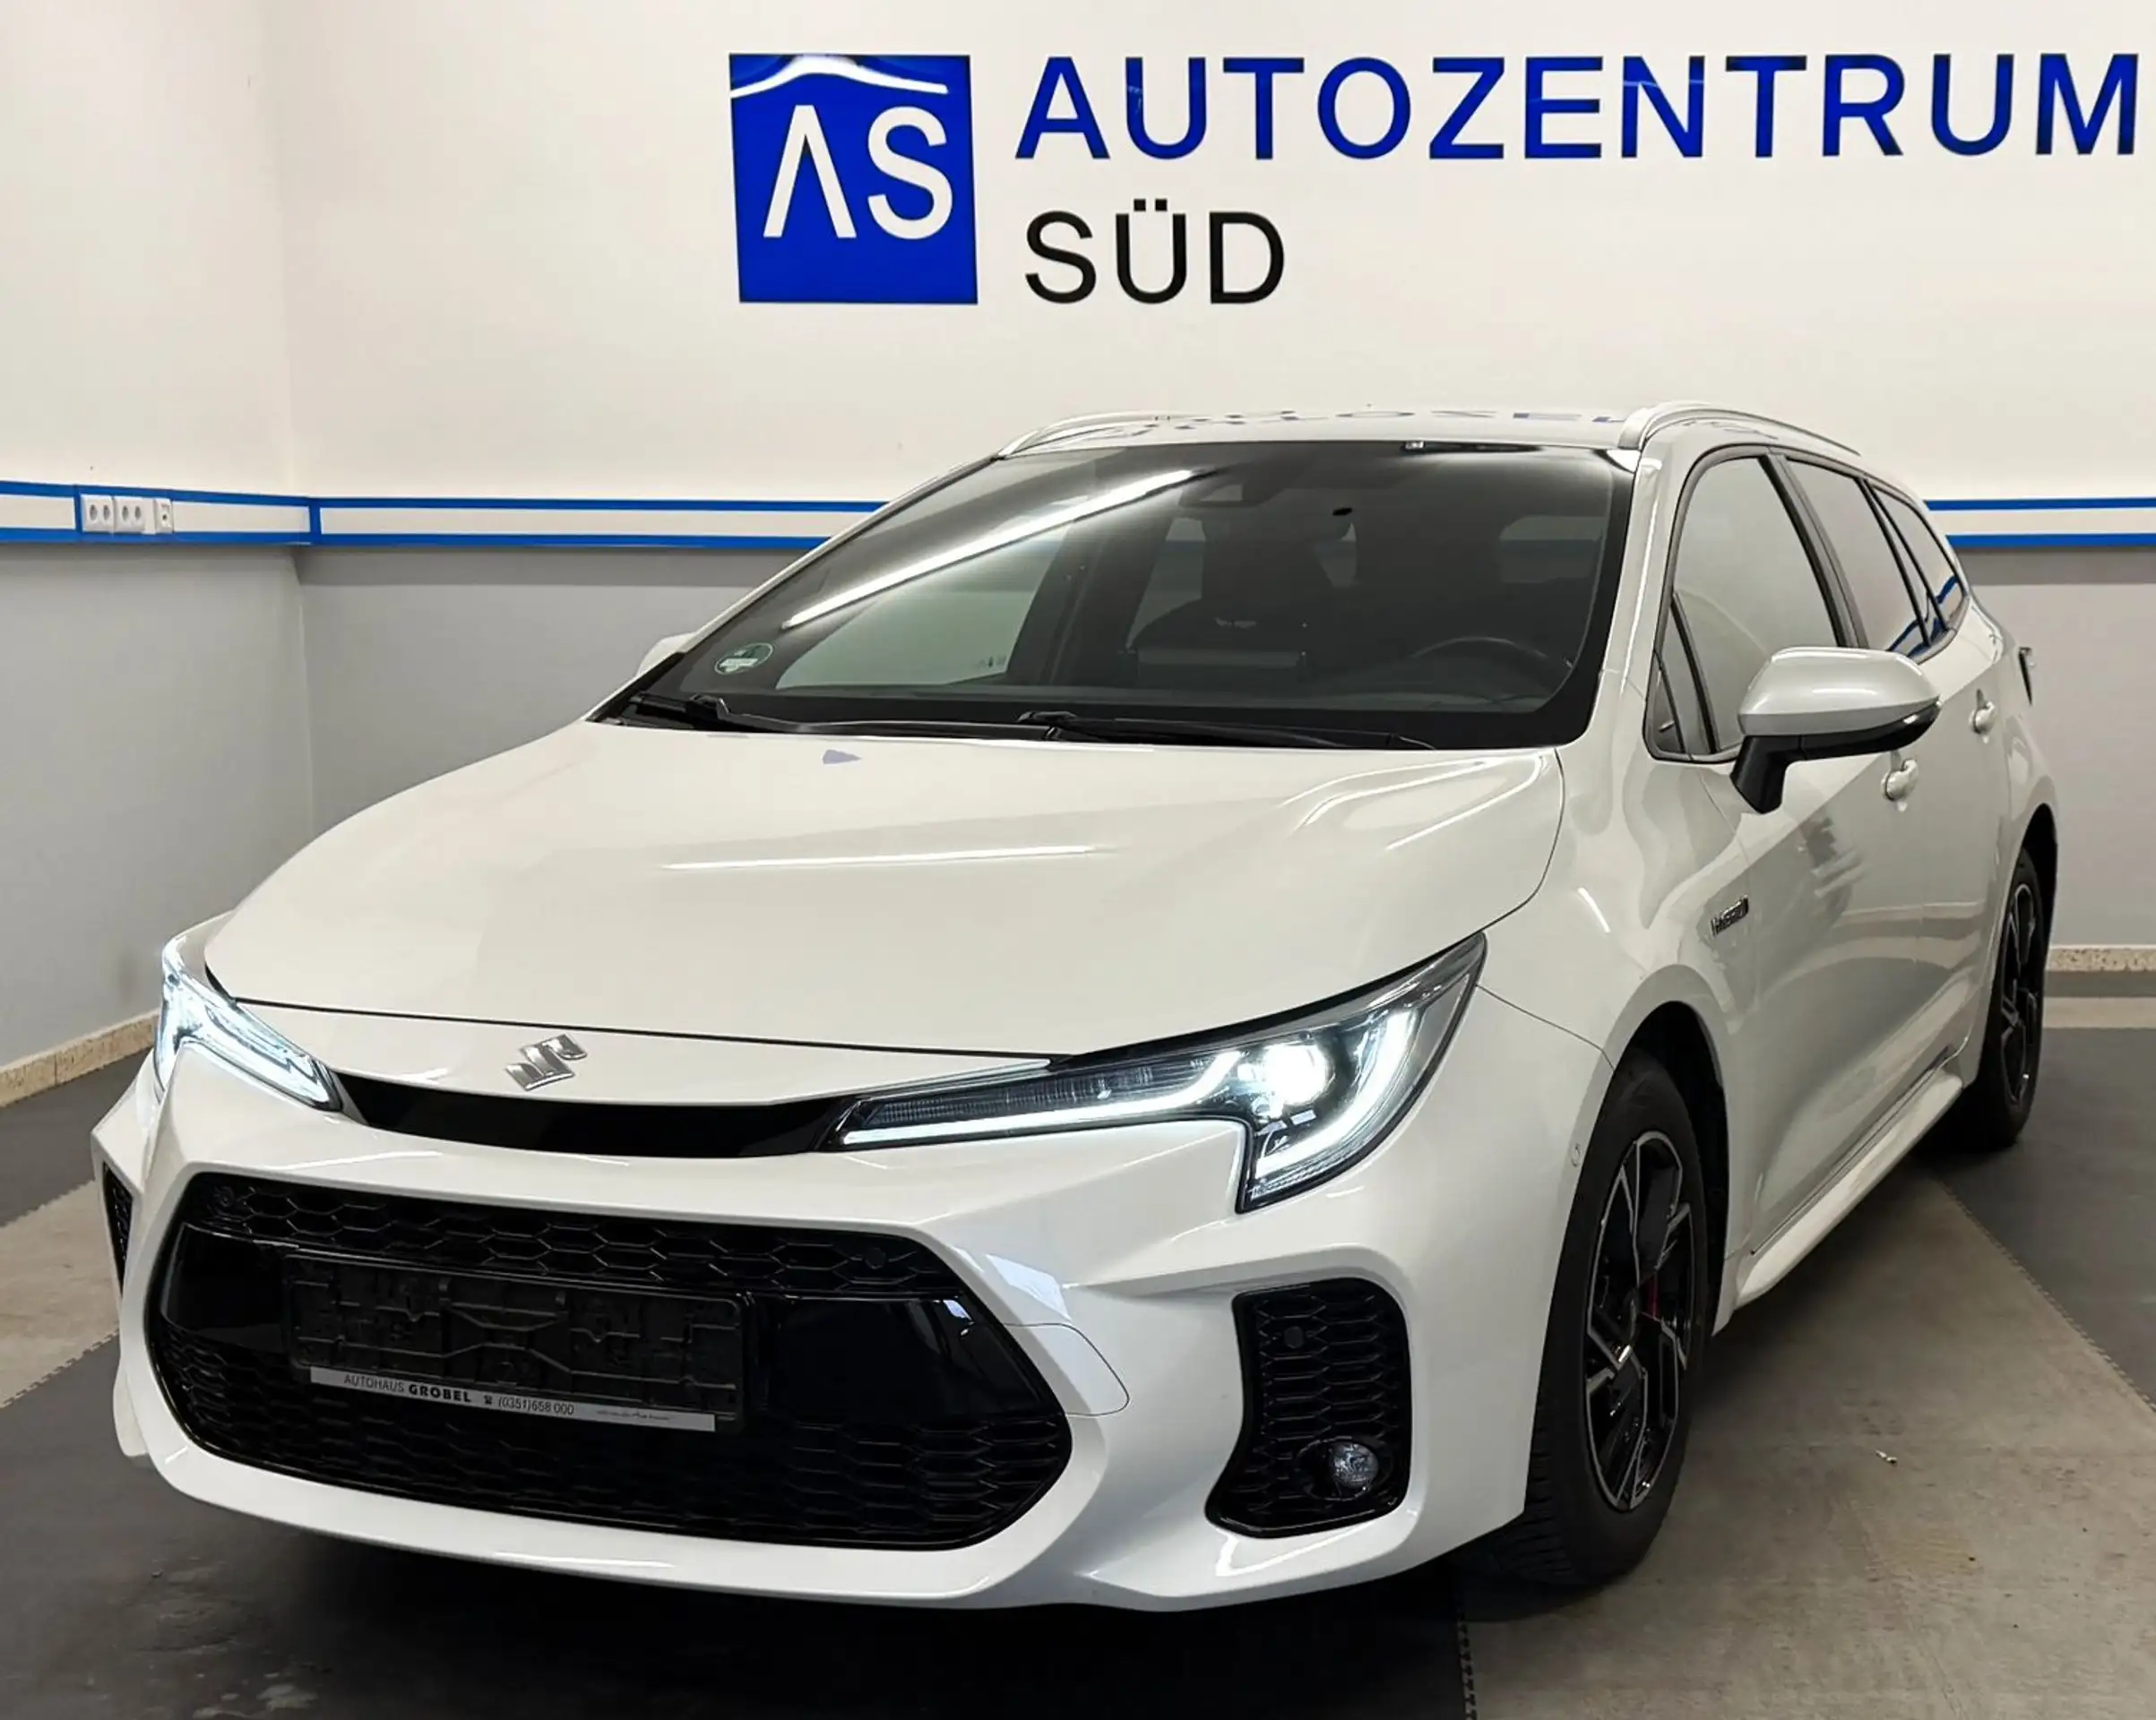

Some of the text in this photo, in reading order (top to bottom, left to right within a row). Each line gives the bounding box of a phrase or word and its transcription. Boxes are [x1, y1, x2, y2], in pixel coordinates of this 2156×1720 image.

[1015, 54, 2138, 159] AUTOZENTRUM
[1026, 199, 1284, 304] SÜD
[344, 1373, 404, 1393] AUTOHAUS
